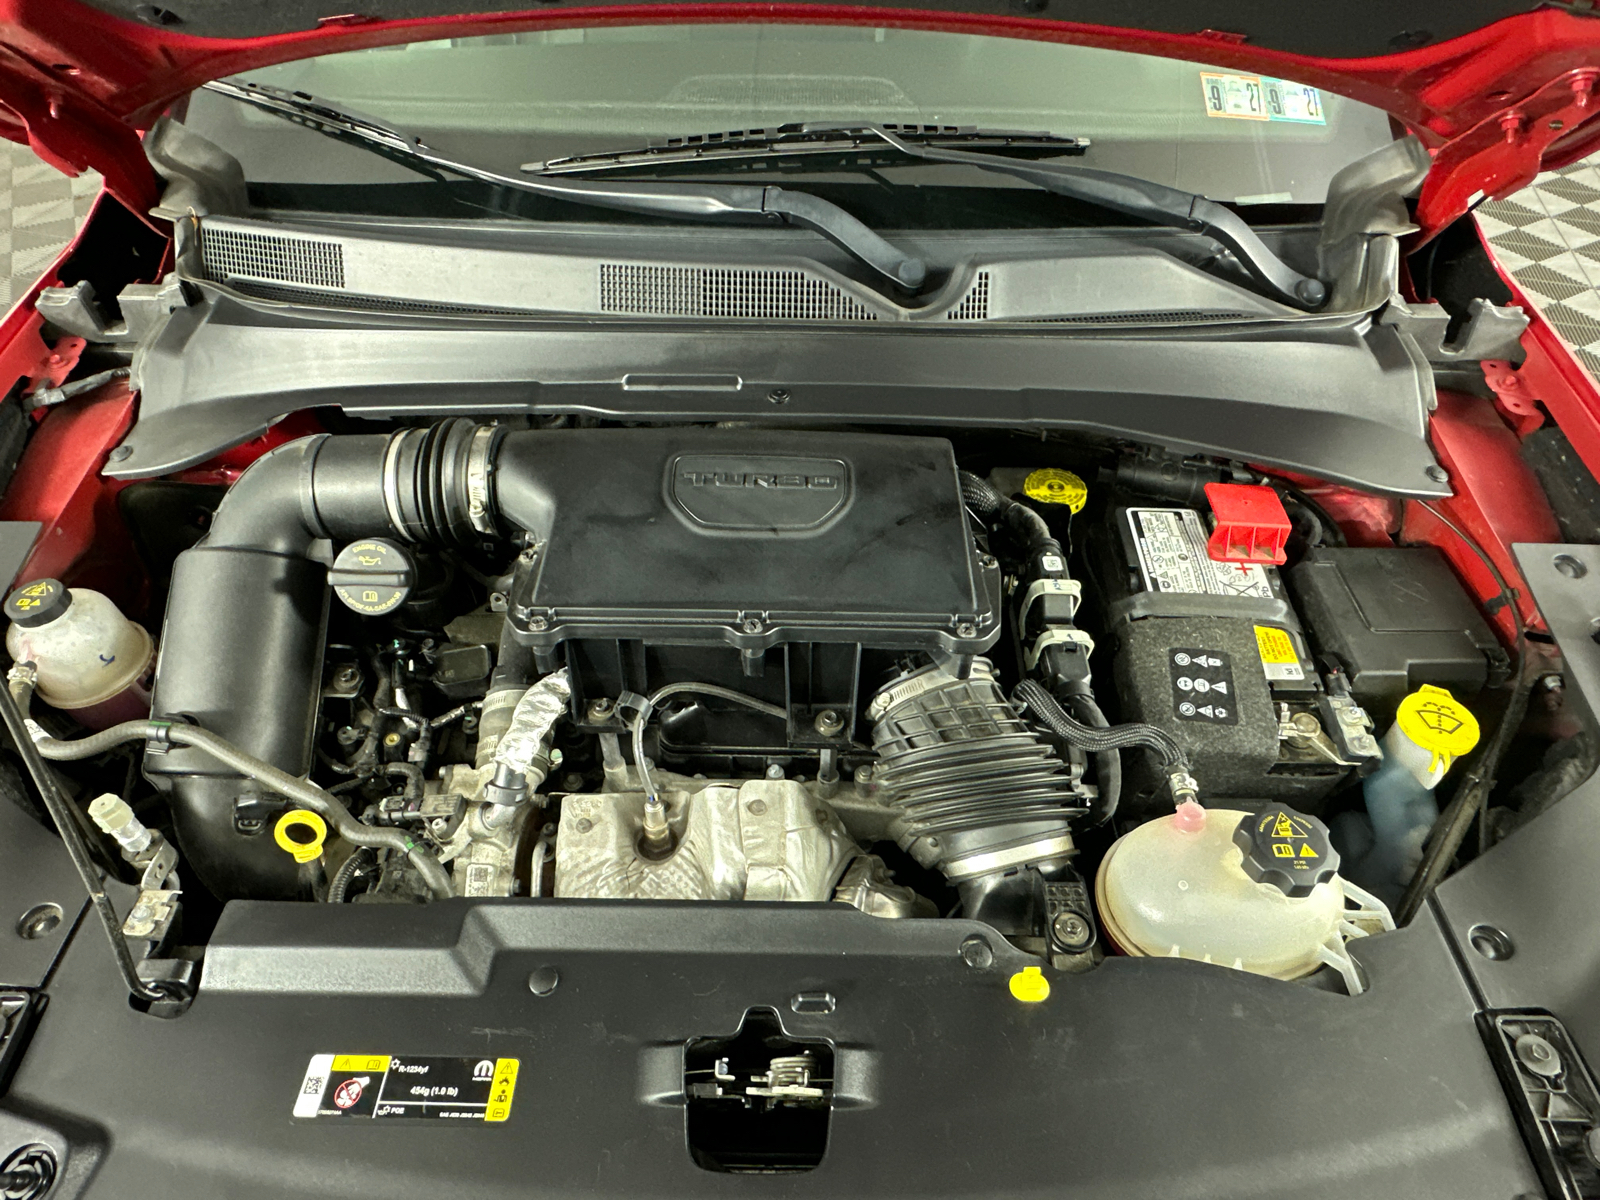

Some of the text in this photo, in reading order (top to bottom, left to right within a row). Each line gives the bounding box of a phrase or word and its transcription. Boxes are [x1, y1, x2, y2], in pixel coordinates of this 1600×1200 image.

[1211, 85, 1222, 111] 9
[1246, 83, 1262, 114] 27
[1269, 88, 1282, 115] 9
[1303, 87, 1319, 116] 27
[683, 471, 838, 490] TURBO
[352, 544, 387, 555] ENGINE OIL
[1261, 585, 1272, 598] Pb
[398, 1065, 429, 1075] R-1234yf
[410, 1086, 459, 1097] 454g (1.0 lb)
